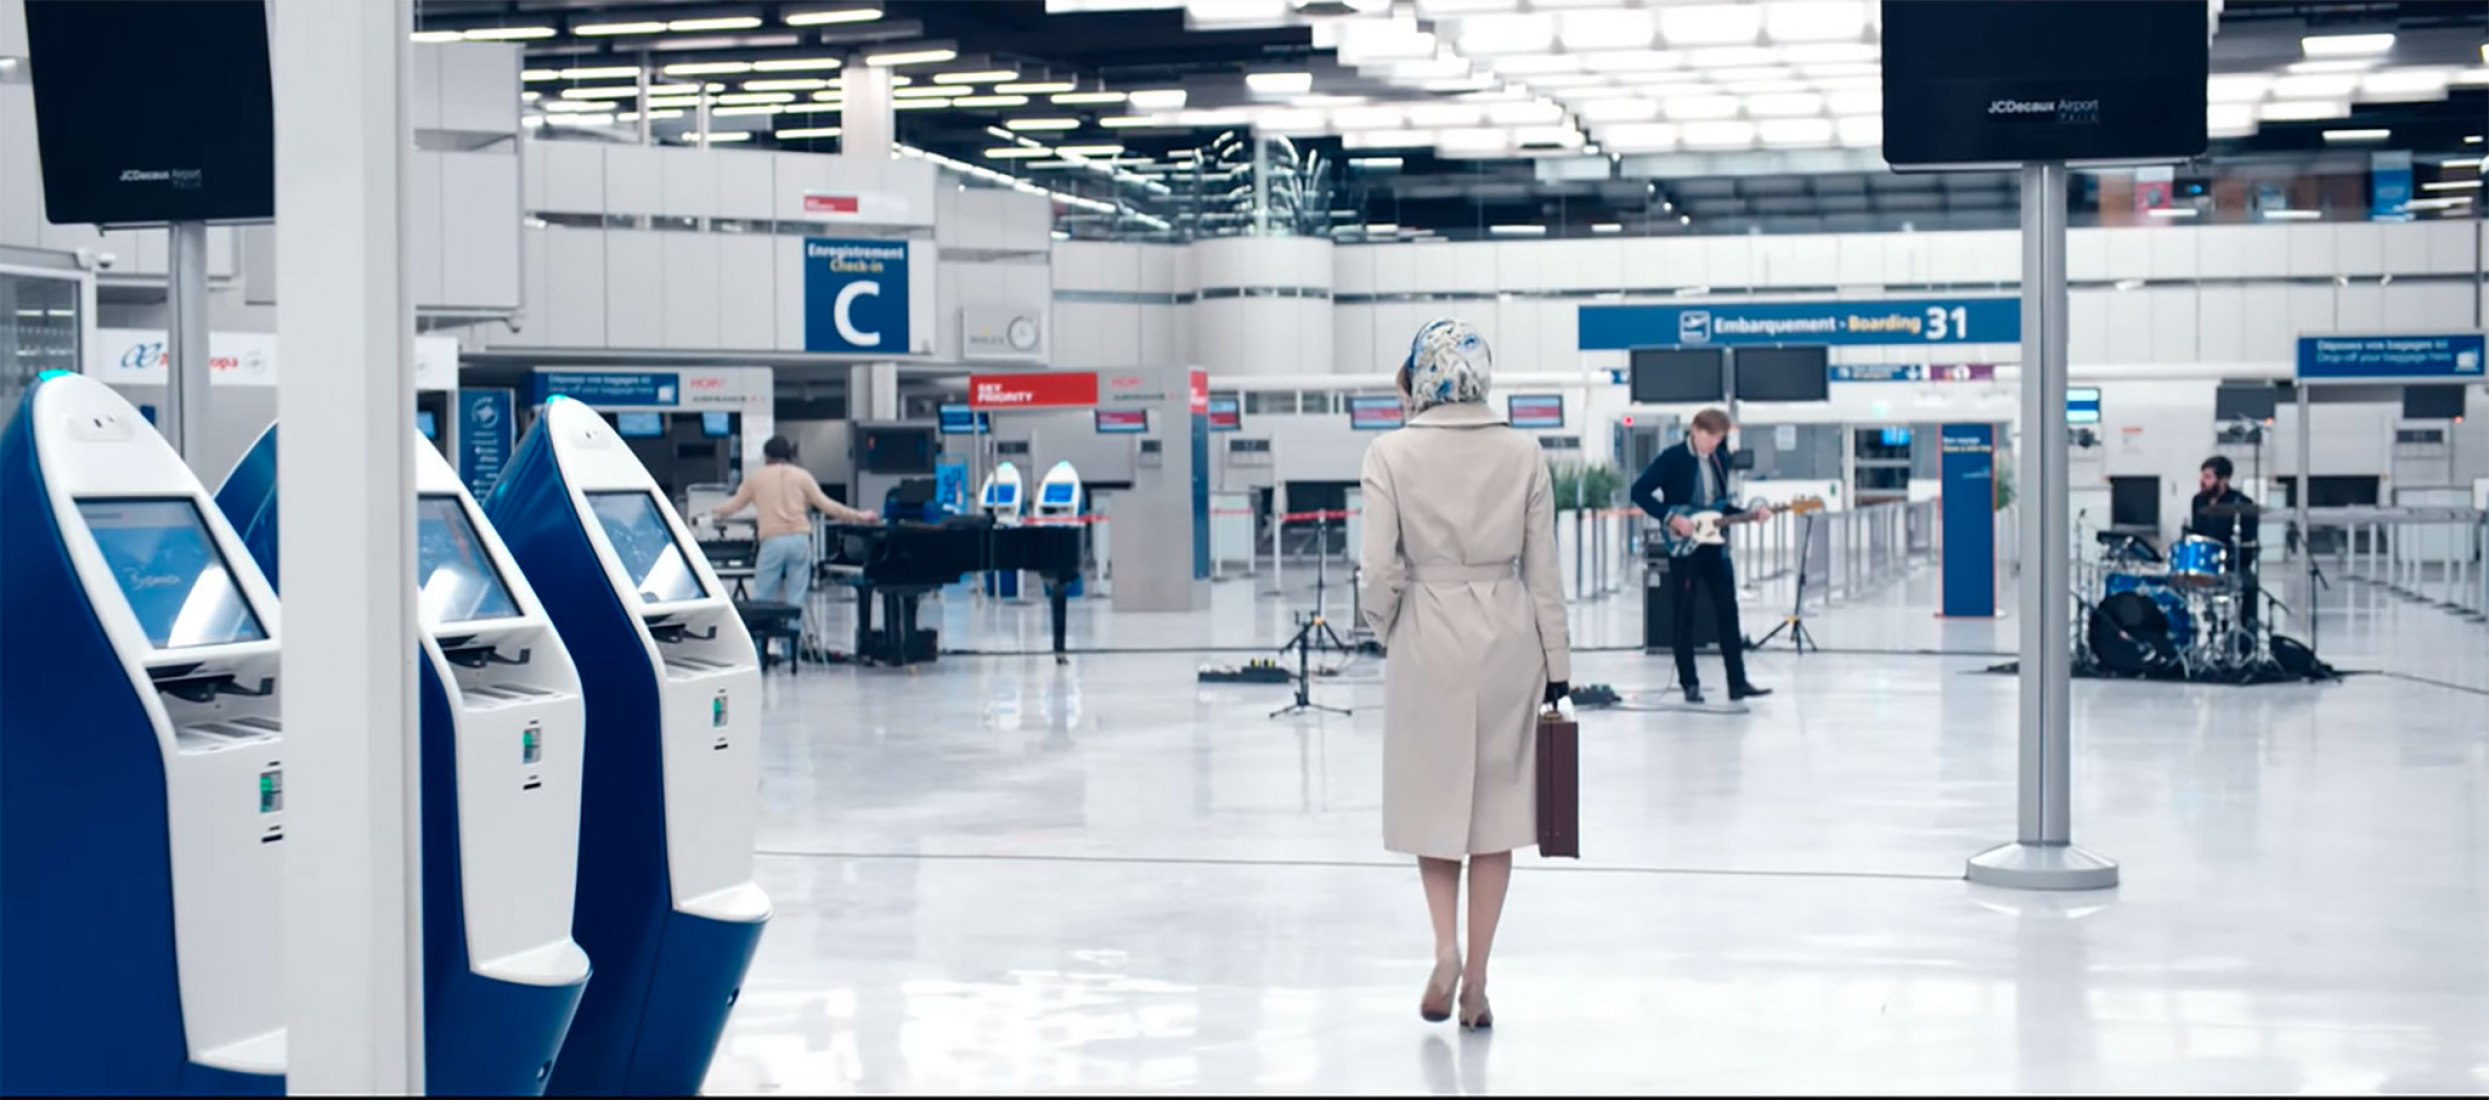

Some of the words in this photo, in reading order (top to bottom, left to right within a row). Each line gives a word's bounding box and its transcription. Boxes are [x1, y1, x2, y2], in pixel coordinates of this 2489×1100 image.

[1988, 100, 2055, 113] JCDecaux
[2058, 99, 2098, 112] Airport
[120, 169, 170, 181] JCDecaux
[808, 243, 904, 260] Enregistrement
[829, 259, 885, 273] Check-in
[833, 279, 881, 347] C
[1715, 316, 1836, 336] Embarquement
[1848, 313, 1921, 334] Boarding
[1925, 305, 1966, 340] 31
[977, 383, 1002, 393] SKY
[977, 391, 1034, 403] PRIORITY
